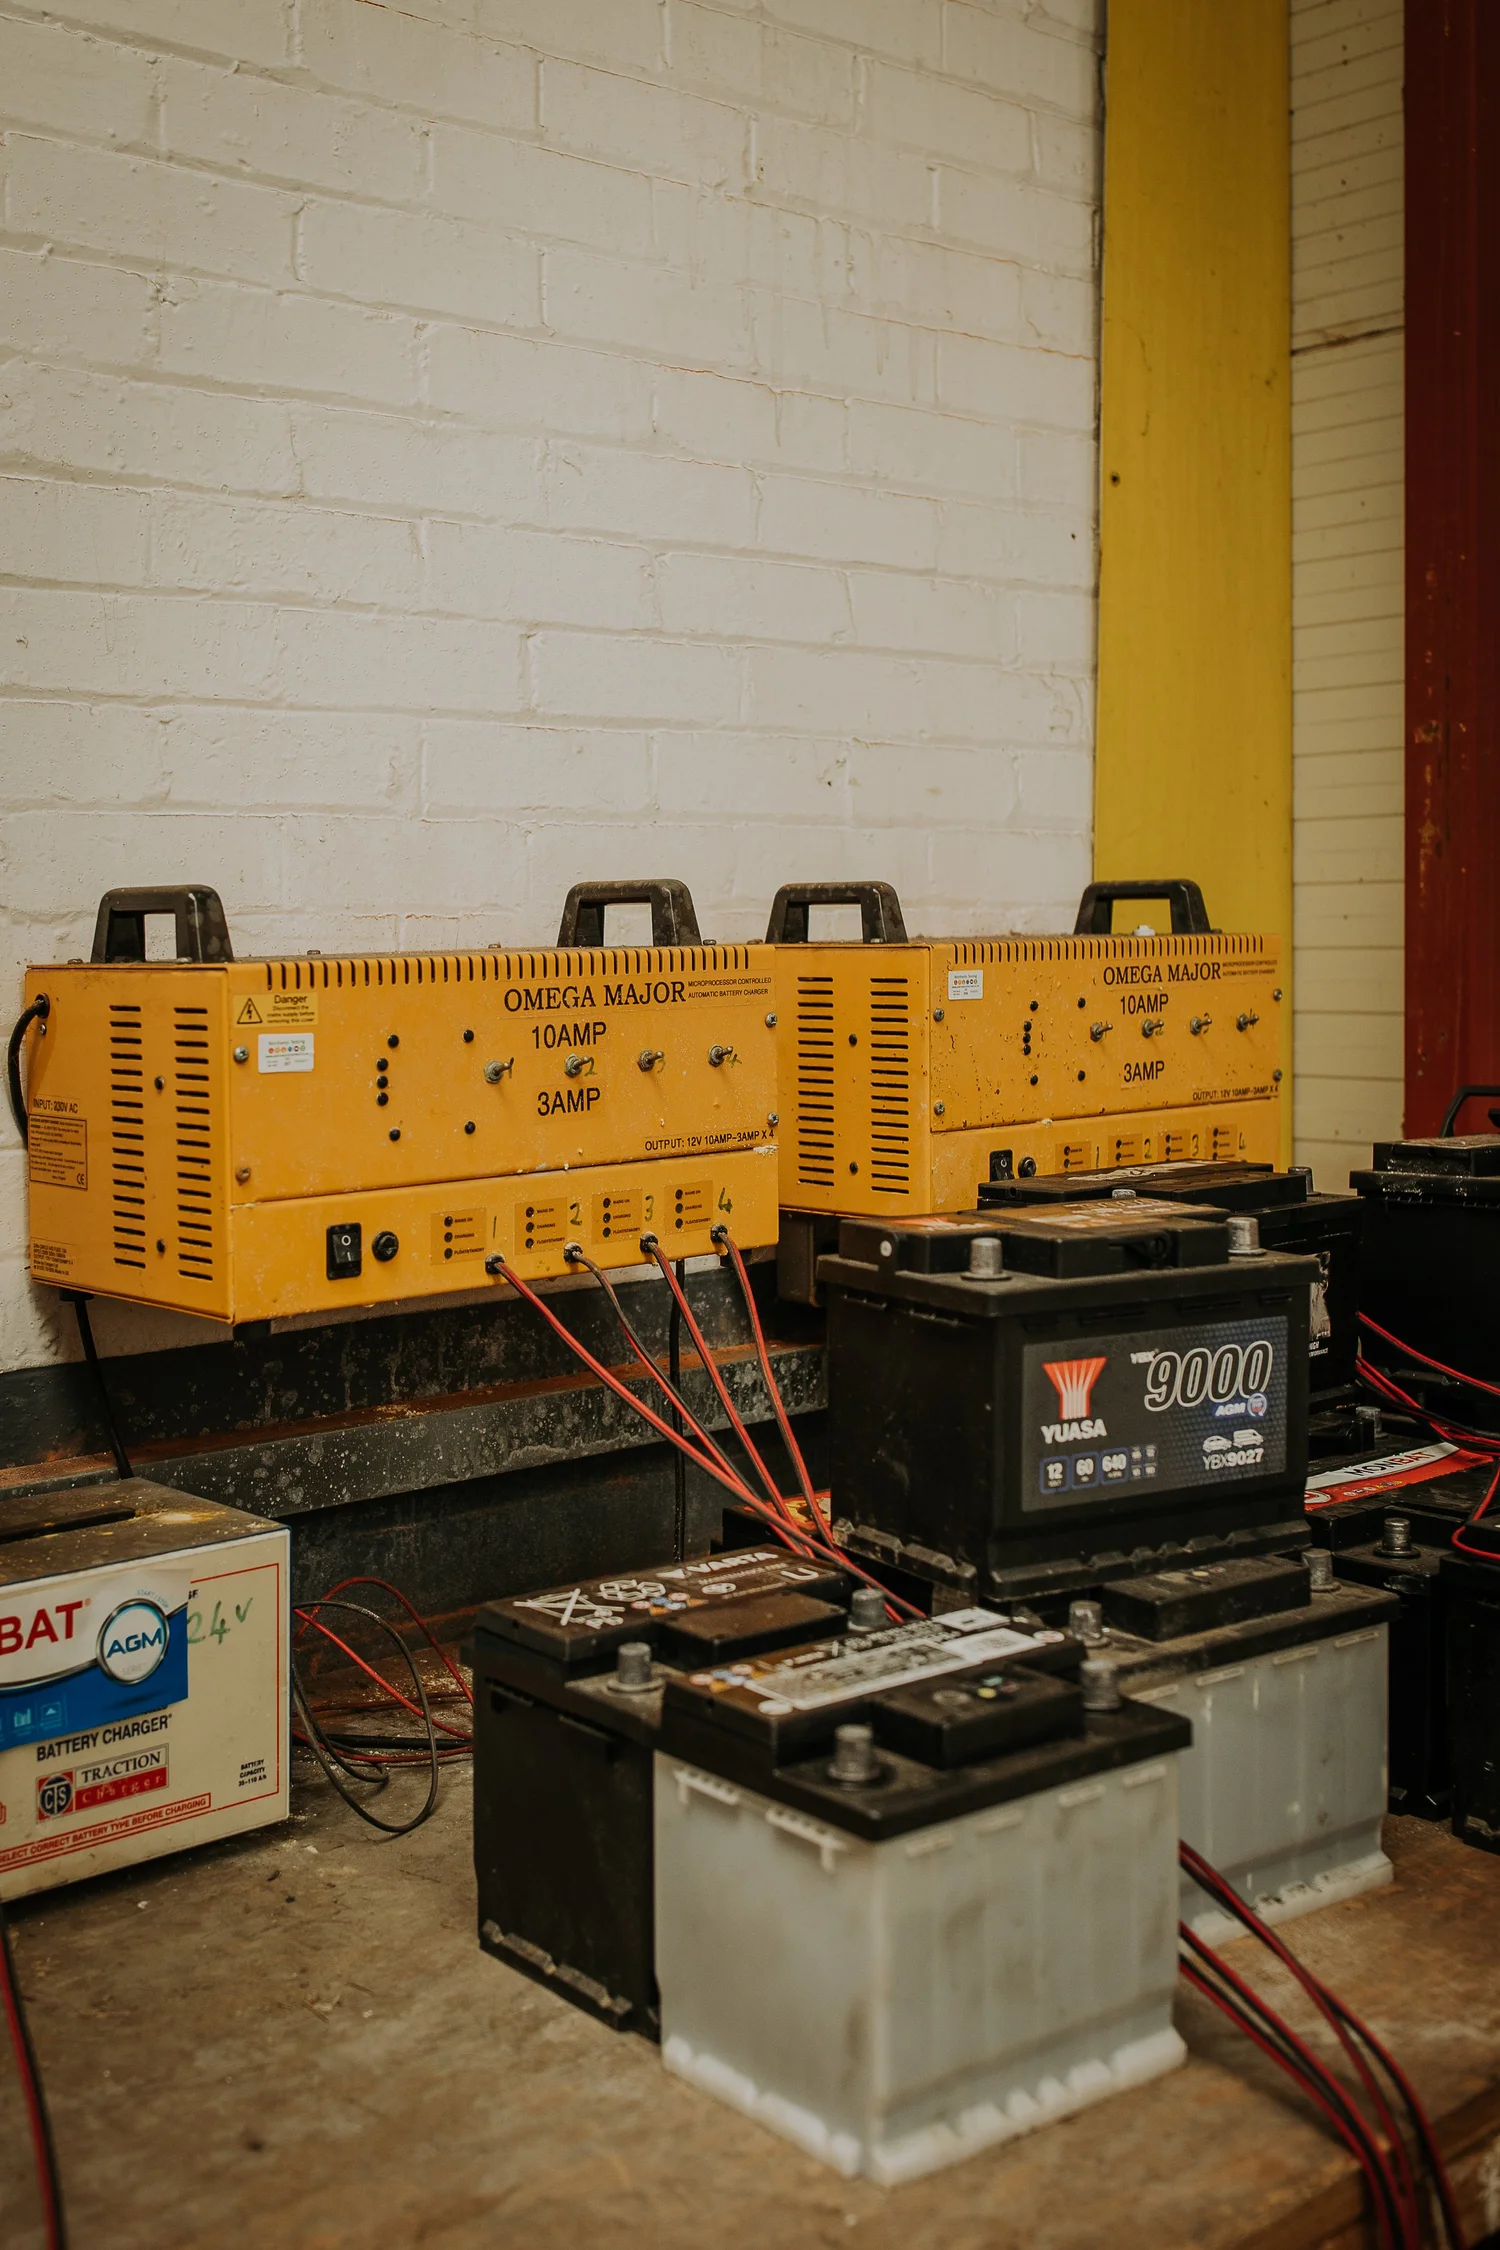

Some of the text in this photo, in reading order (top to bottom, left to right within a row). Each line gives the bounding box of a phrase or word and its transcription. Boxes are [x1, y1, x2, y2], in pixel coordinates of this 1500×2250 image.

[688, 977, 772, 987] MICROPROCESSOR CONTROLLED
[1103, 961, 1221, 985] OMEGA MAJOR
[274, 995, 308, 1005] Danger
[503, 981, 687, 1012] OMEGA MAJOR
[688, 988, 769, 998] AUTOMATIC BATTERY CHARGER
[1120, 993, 1169, 1015] 10AMP
[531, 1021, 607, 1050] 10AMP
[584, 1056, 597, 1077] 2
[1123, 1060, 1165, 1083] 3AMP
[33, 1098, 78, 1114] INPUT: 230V AC
[537, 1086, 601, 1117] 3AMP
[1192, 1091, 1219, 1101] OUTPUT:
[1220, 1089, 1231, 1098] 12V
[644, 1139, 685, 1152] OUTPUT:
[686, 1136, 702, 1148] 12V
[761, 1130, 768, 1140] X
[768, 1129, 775, 1139] 4
[644, 1194, 655, 1222] 3
[718, 1187, 733, 1214] 4
[569, 1202, 583, 1226] 2
[1144, 1340, 1273, 1412] 9000
[1215, 1402, 1246, 1417] AGM
[1040, 1418, 1108, 1445] YUASA
[1046, 1462, 1063, 1480] 12
[1102, 1453, 1127, 1472] 640
[1202, 1447, 1265, 1470] YBX9027
[1344, 1451, 1436, 1477] MONBAT
[685, 1551, 779, 1574] VARTA
[106, 1627, 163, 1658] AGM
[36, 1715, 169, 1761] BATTERY CHARGER
[81, 1751, 162, 1784] TRACTION
[30, 1836, 71, 1854] CORRECT
[72, 1826, 109, 1842] BATTERY
[110, 1820, 130, 1833] TYPE
[132, 1810, 164, 1825] BEFORE
[165, 1797, 207, 1816] CHARGING
